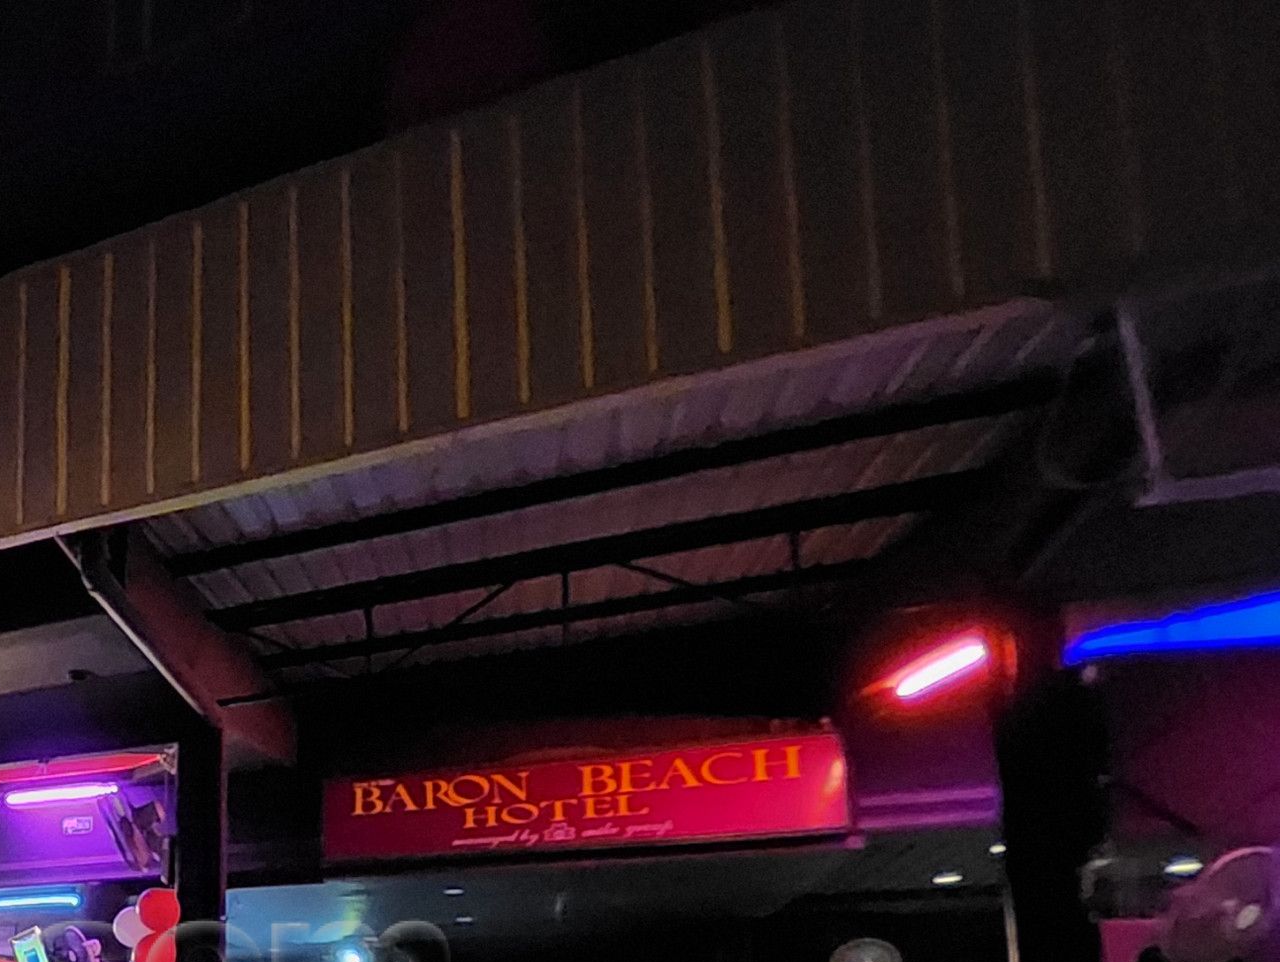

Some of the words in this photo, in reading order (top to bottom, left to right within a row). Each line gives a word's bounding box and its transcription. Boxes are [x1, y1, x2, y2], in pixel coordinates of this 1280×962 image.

[352, 771, 530, 816] BARON
[578, 744, 804, 797] BEACH
[463, 794, 650, 829] HOTEL
